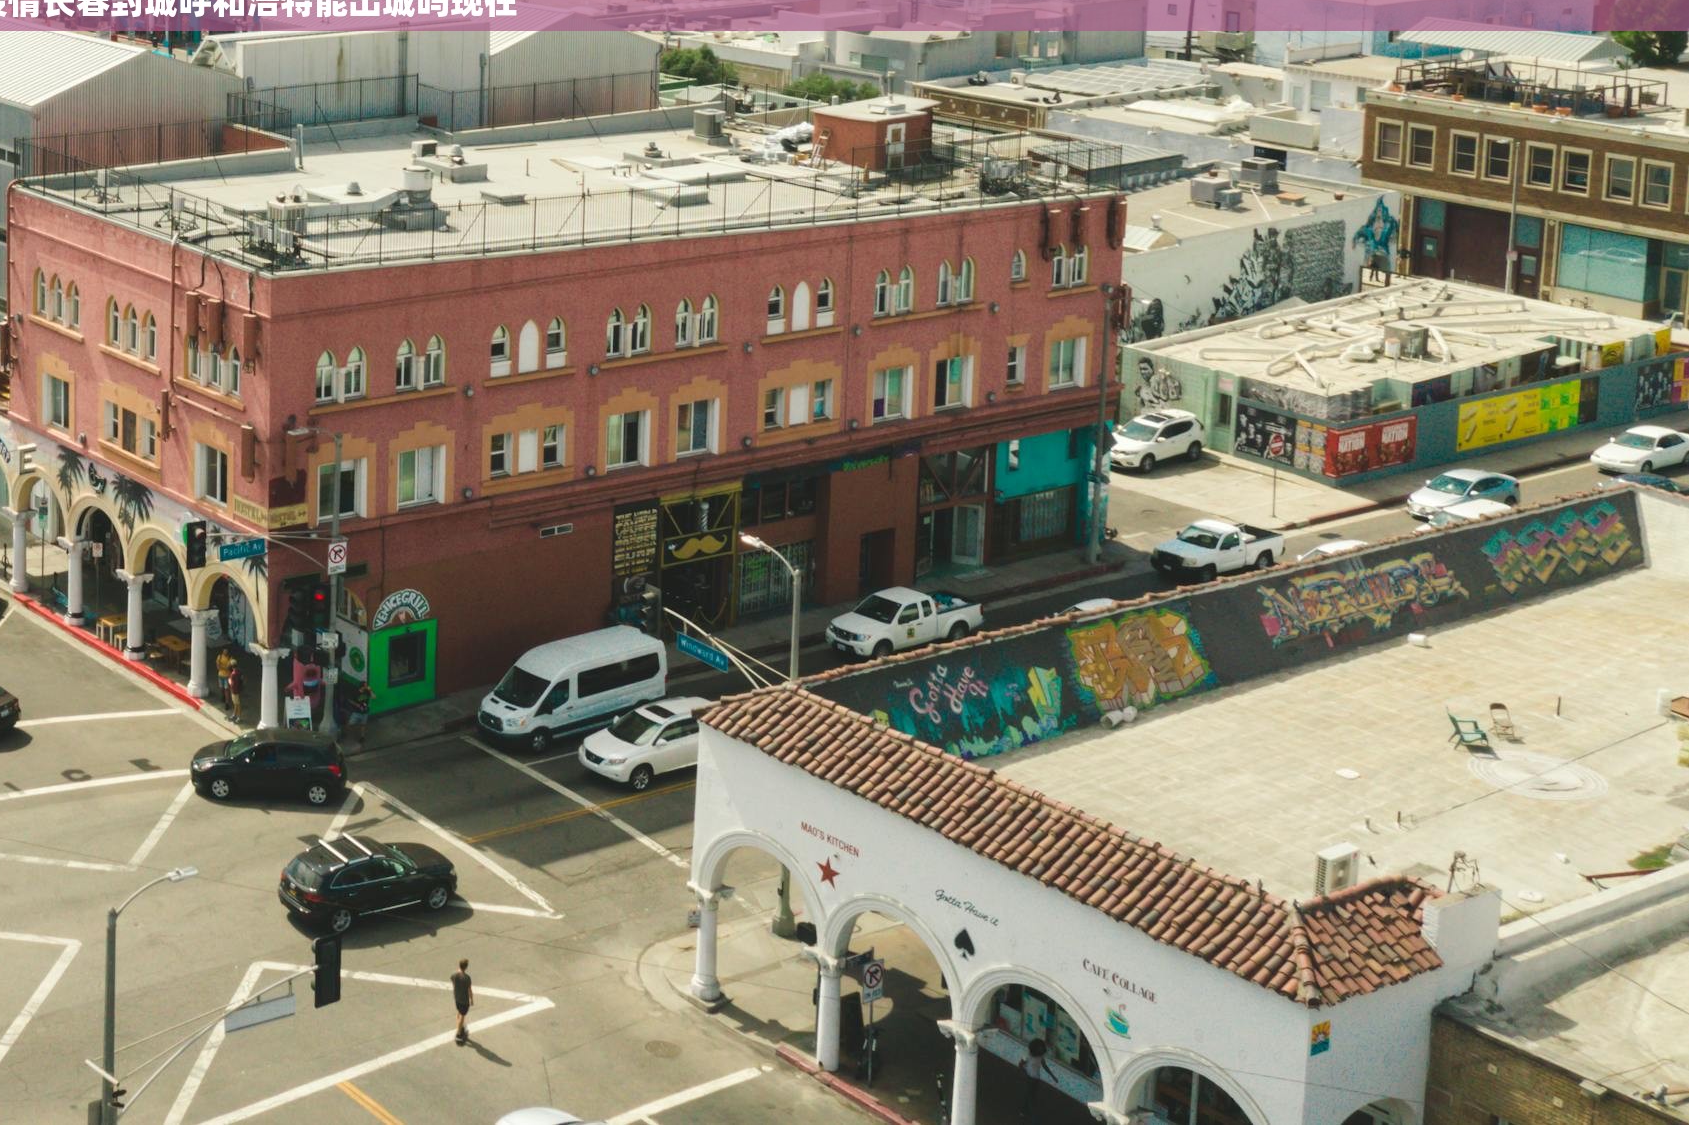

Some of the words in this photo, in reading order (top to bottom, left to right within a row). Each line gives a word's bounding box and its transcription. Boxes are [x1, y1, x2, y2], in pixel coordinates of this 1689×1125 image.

[223, 545, 251, 557] Pacific
[253, 542, 263, 550] Av
[800, 821, 825, 841] MAO'S
[826, 833, 860, 858] KITCHEN
[934, 888, 962, 910] Gotta
[963, 900, 989, 922] Have
[1112, 972, 1157, 1004] COLLAGE
